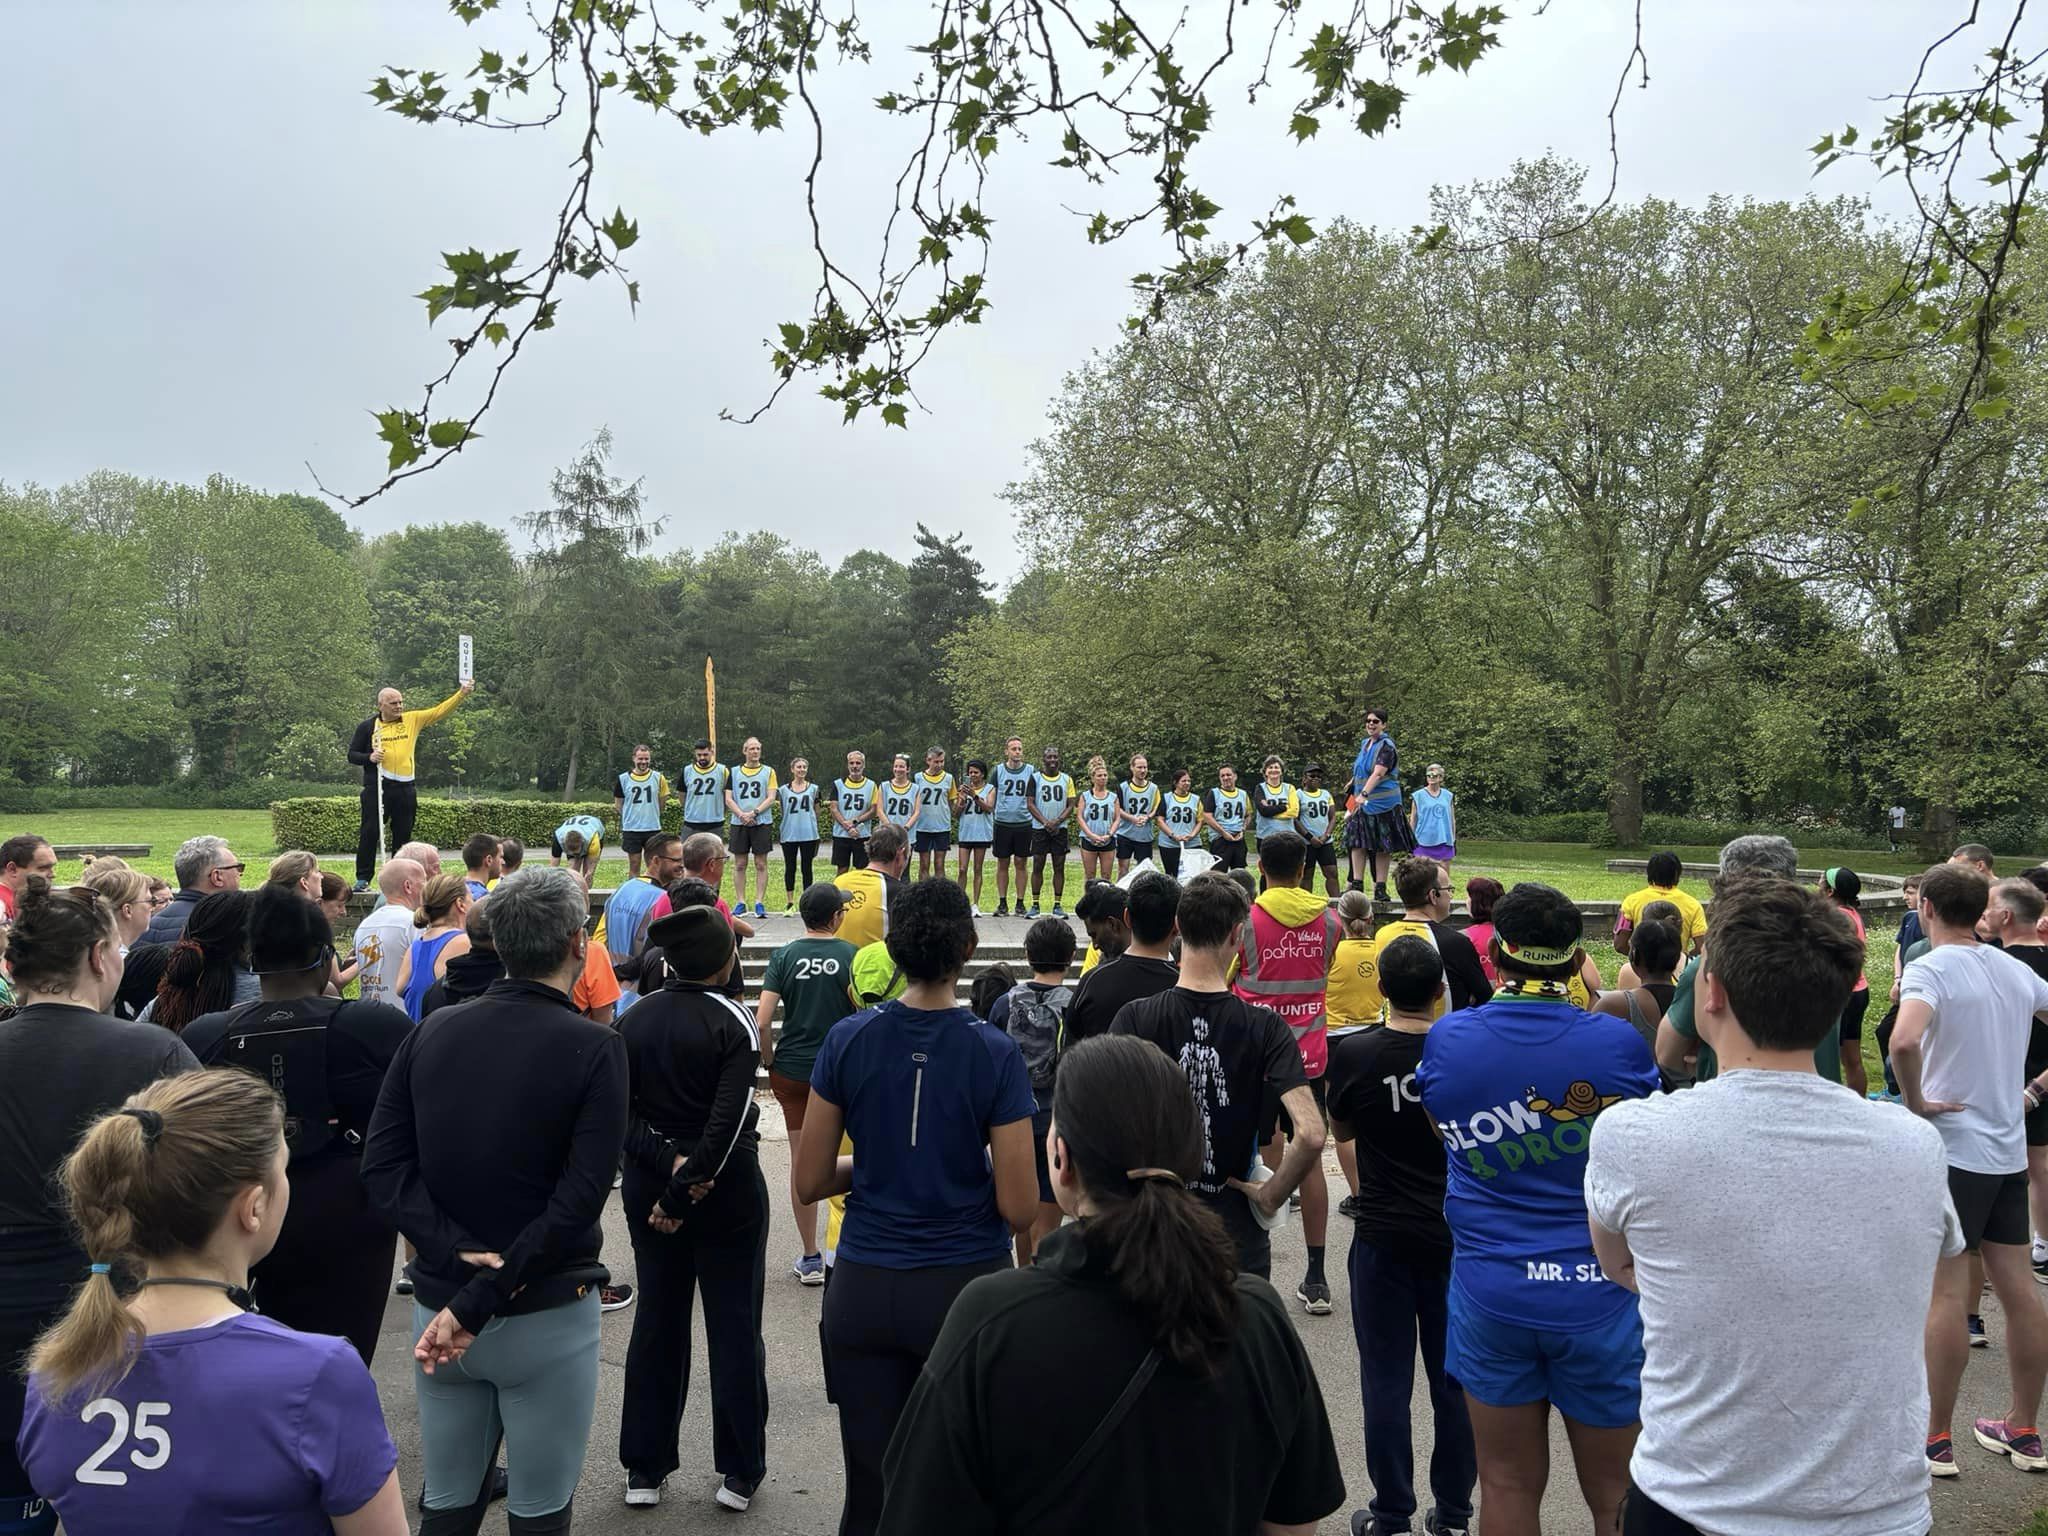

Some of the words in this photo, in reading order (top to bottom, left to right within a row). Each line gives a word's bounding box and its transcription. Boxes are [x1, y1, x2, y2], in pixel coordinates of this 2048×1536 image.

[463, 642, 474, 675] QUIET
[631, 786, 652, 804] 21
[693, 777, 715, 796] 22
[739, 781, 761, 799] 23
[1004, 779, 1026, 797] 29
[1041, 784, 1063, 802] 30
[788, 795, 810, 814] 24
[843, 793, 864, 811] 25
[922, 787, 943, 806] 27
[1128, 797, 1149, 815] 32
[888, 797, 909, 816] 26
[1089, 803, 1109, 821] 31
[1171, 806, 1193, 824] 33
[1223, 801, 1243, 820] 34
[1307, 800, 1328, 819] 36
[1297, 930, 1322, 944] Vitality
[1263, 940, 1323, 962] parkrun
[795, 958, 840, 979] 250
[1438, 1100, 1541, 1151] SLOW
[1467, 1149, 1498, 1180] &
[1496, 1116, 1595, 1172] DRO
[1527, 1261, 1571, 1281] MR.
[1576, 1263, 1609, 1282] SL
[75, 1398, 171, 1485] 25
